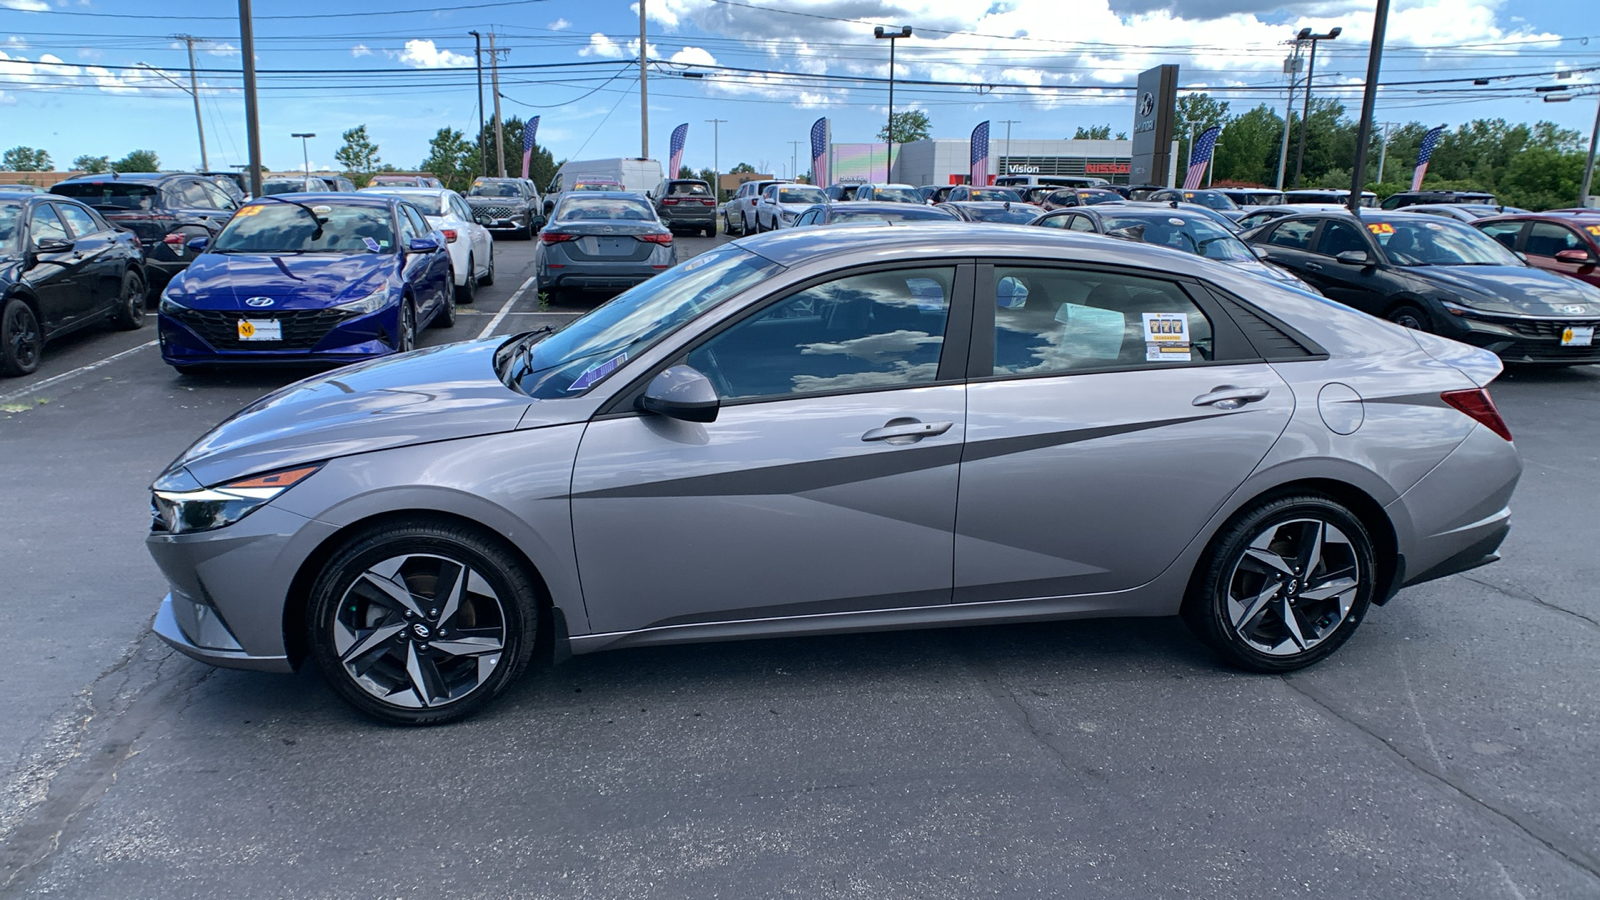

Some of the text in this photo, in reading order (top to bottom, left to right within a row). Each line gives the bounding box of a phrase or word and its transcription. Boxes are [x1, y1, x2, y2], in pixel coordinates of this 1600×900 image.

[1009, 164, 1039, 174] Vision
[1368, 223, 1394, 234] 24
[241, 325, 251, 333] M
